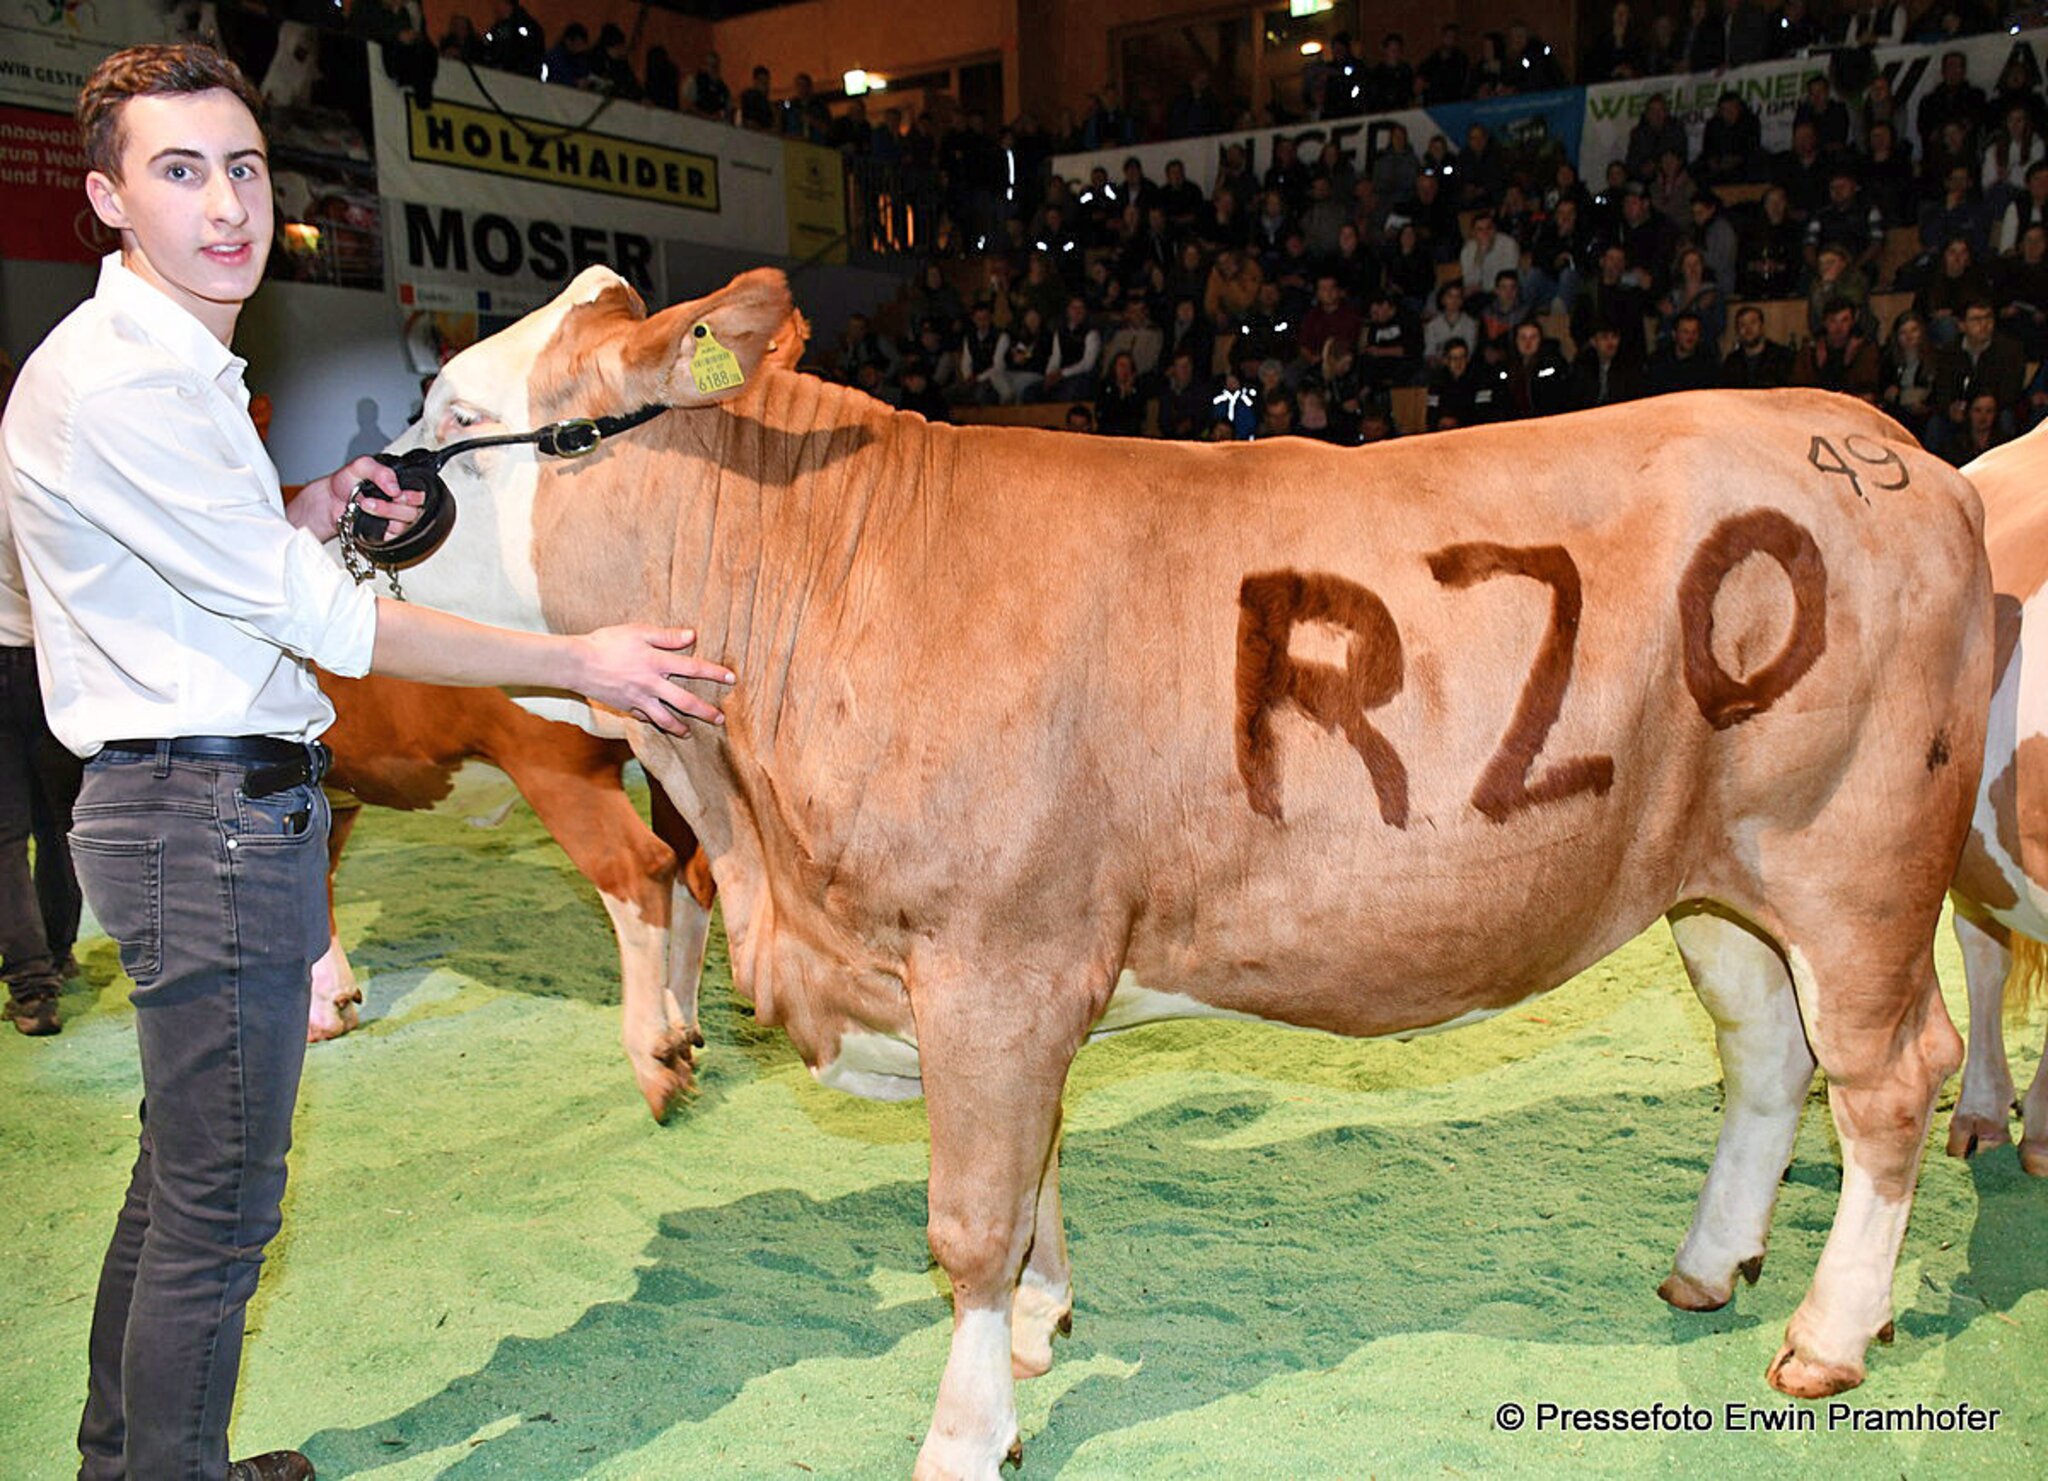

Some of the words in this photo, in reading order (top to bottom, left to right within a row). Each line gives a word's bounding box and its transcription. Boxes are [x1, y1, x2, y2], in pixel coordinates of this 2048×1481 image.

[0, 61, 31, 79] WIR
[1, 167, 38, 186] und
[427, 113, 707, 198] HOLZHAIDER
[405, 203, 655, 291] MOSER
[698, 370, 730, 392] 6188
[1809, 434, 1911, 500] 49
